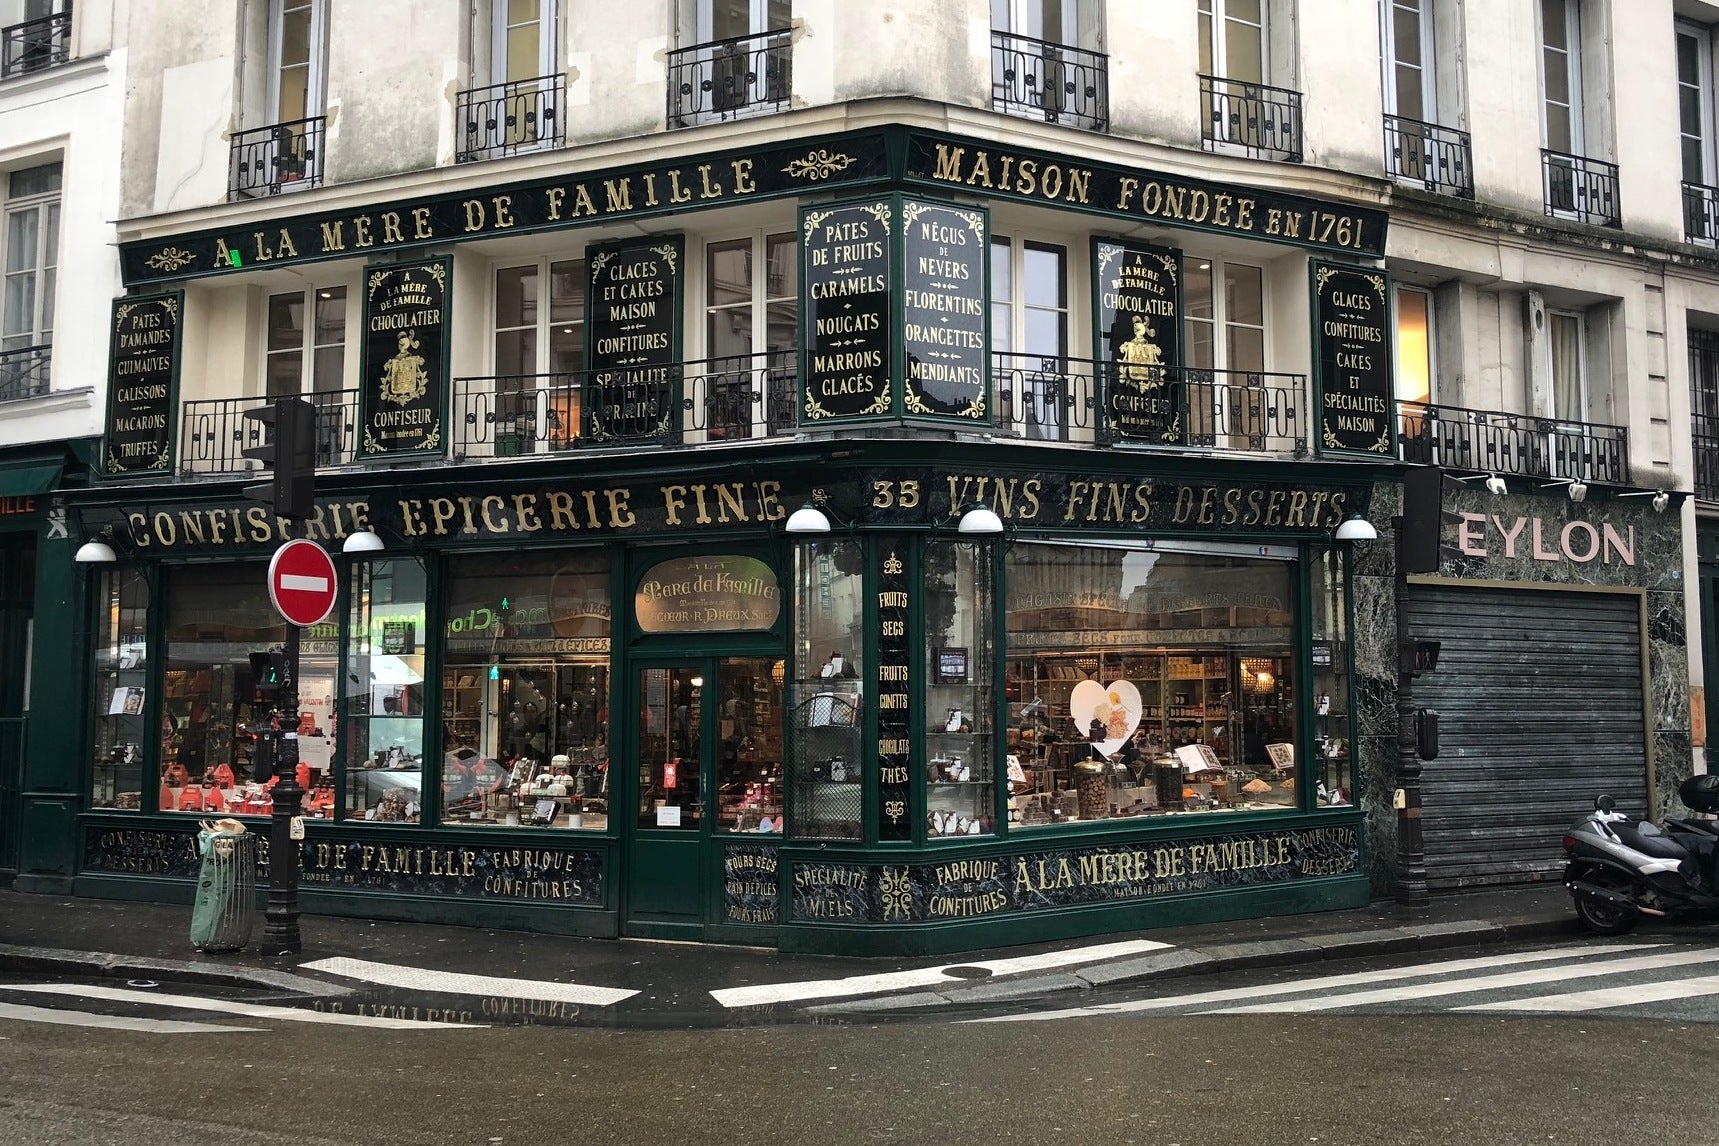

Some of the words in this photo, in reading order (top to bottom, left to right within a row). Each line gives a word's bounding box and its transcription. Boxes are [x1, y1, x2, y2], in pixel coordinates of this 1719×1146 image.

[932, 143, 1092, 204] MAISON
[1265, 208, 1301, 238] EN
[1308, 210, 1364, 248] 1761
[254, 227, 298, 261] LA
[462, 195, 514, 232] DE
[546, 159, 756, 220] FAMILLE
[825, 221, 869, 243] PÂTES
[812, 248, 829, 266] DE
[834, 241, 883, 264] FRUITS
[939, 246, 949, 257] DE
[610, 261, 657, 281] GLACES
[919, 257, 969, 280] NEVERS
[1118, 266, 1132, 276] LA
[387, 286, 400, 297] LA
[604, 286, 616, 301] ET
[620, 280, 664, 300] CAKES
[811, 274, 885, 300] CARAMELS
[1111, 278, 1125, 290] DE
[1125, 278, 1166, 296] FAMILLE
[380, 299, 392, 312] DE
[393, 294, 433, 307] FAMILLE
[610, 301, 656, 322] MAISON
[905, 289, 982, 316] FLORENTINS
[1103, 292, 1174, 317] CHOCOLATIER
[1332, 291, 1371, 311] GLACES
[371, 309, 440, 332] CHOCOLATIER
[816, 312, 879, 336] NOUGATS
[120, 329, 171, 348] D'AMANDES
[905, 323, 983, 349] ORANGETTES
[1324, 320, 1382, 343] CONFITURES
[597, 332, 668, 354] CONFITURES
[118, 356, 170, 376] GUIMAUVES
[814, 350, 882, 373] MARRONS
[1336, 352, 1372, 371] CAKES
[910, 361, 981, 385] MENDIANTS
[1349, 375, 1360, 389] ET
[118, 384, 167, 402] CALISSONS
[821, 373, 874, 396] GLACÉS
[116, 414, 166, 432] MACARONS
[374, 410, 432, 428] CONFISEUR
[1338, 415, 1375, 433] MAISON
[120, 441, 158, 458] TRUFFES
[399, 488, 636, 537] EPICERIE
[660, 480, 786, 526] FINE
[872, 480, 920, 508] 35
[947, 475, 1042, 519] VINS
[1064, 480, 1152, 522] FINS
[1172, 486, 1346, 528] DESSERTS
[879, 592, 907, 608] FRUITS
[882, 621, 904, 636] SECS
[879, 665, 908, 681] FRUITS
[879, 693, 908, 709] CONFITS
[104, 854, 169, 873] DESSERTS
[316, 843, 347, 869] DE
[361, 845, 476, 877] FAMILLE
[493, 850, 574, 872] FABRIQUE
[728, 855, 753, 871] FOURS
[756, 855, 777, 873] SECS
[1015, 857, 1034, 892] À
[1037, 858, 1074, 890] LA
[1080, 849, 1150, 886] MÈRE
[1153, 847, 1186, 878] DE
[1189, 836, 1292, 875] FAMILLE
[526, 870, 538, 879] DE
[936, 860, 999, 886] FABRIQUE
[484, 875, 582, 898] CONFITURES
[963, 882, 973, 893] DE
[809, 899, 853, 917] MIELS
[929, 888, 1007, 916] CONFITURES
